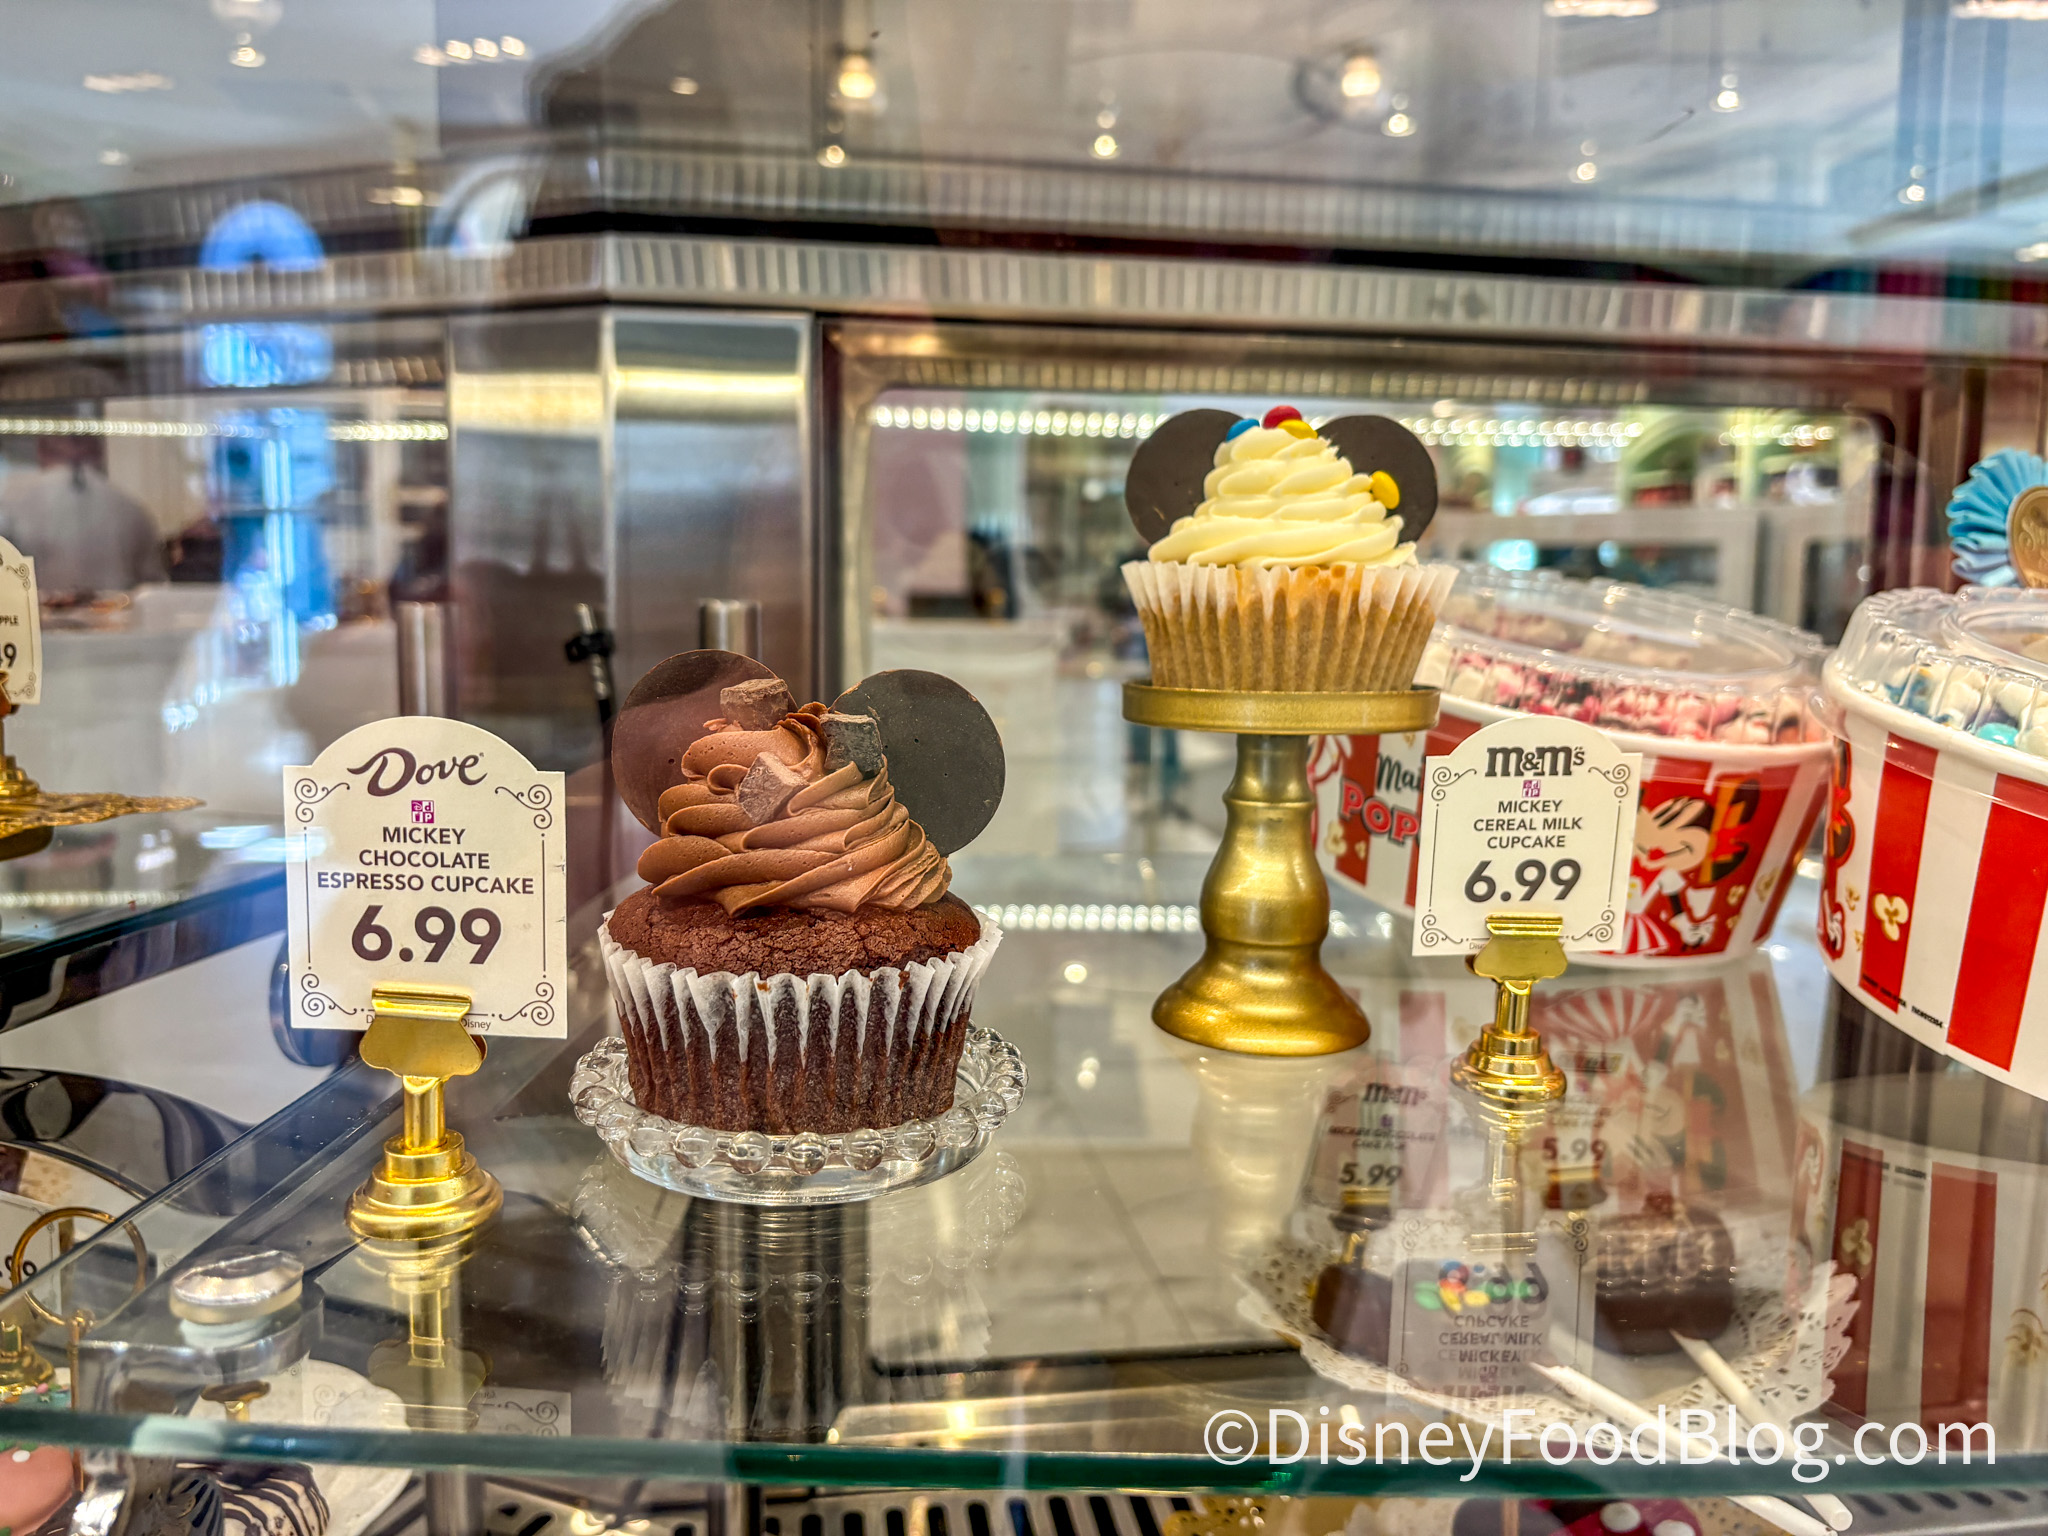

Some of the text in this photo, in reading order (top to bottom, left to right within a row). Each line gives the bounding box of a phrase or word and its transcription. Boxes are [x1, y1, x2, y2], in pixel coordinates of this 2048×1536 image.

[1498, 800, 1562, 813] MICKEY
[1474, 817, 1583, 832] CEREAL MILK
[382, 827, 466, 845] MICKEY
[1487, 835, 1566, 849] CUPCAKE
[359, 850, 490, 869] CHOCOLATE
[317, 872, 535, 895] ESPRESSO CUPCAKE
[1464, 858, 1581, 903] 6.99
[351, 905, 502, 965] 6.99
[1542, 1137, 1606, 1162] 5.99
[1339, 1162, 1403, 1186] 5.99
